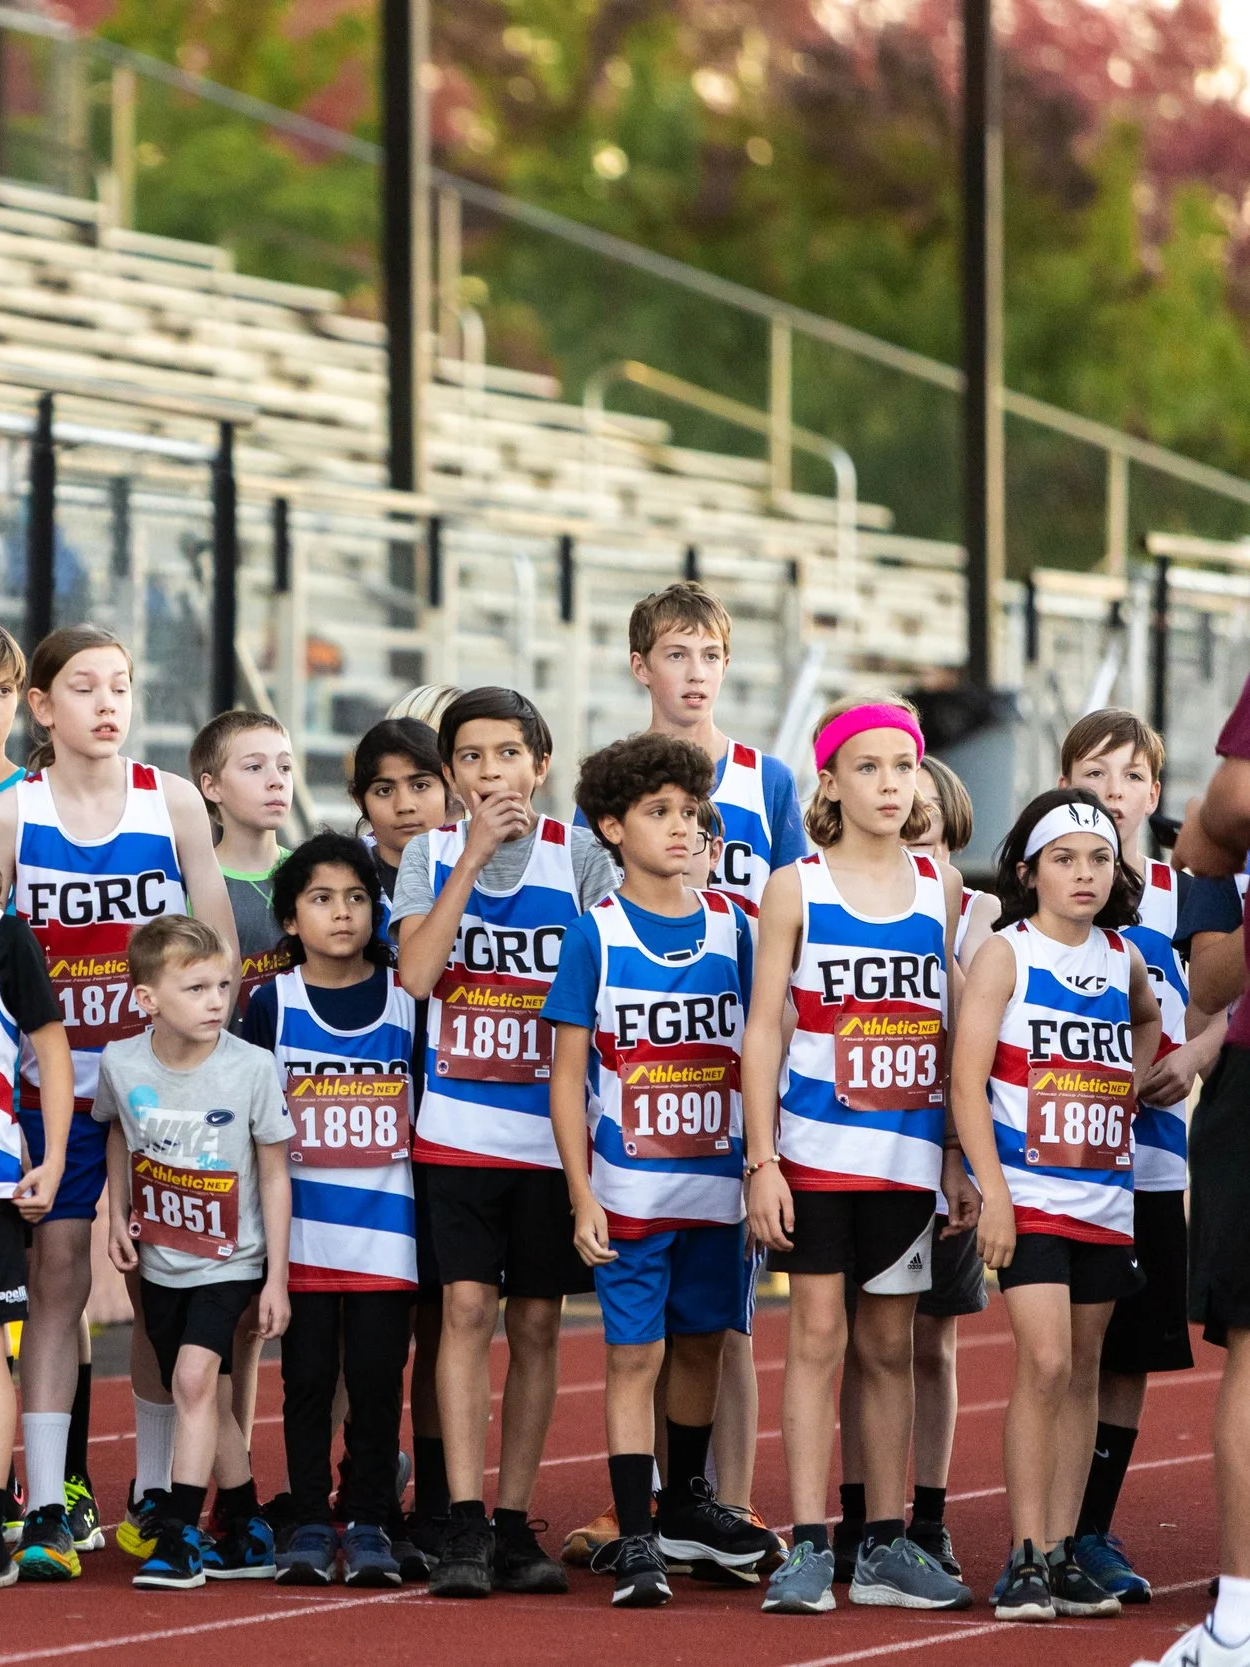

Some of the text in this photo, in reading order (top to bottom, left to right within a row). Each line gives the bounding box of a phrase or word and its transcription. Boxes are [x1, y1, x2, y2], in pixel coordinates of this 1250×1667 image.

[29, 870, 167, 926] FGRC
[49, 957, 127, 979] Athletic
[446, 985, 523, 1008] Athletic
[451, 1014, 541, 1061] 1891
[616, 993, 738, 1048] FGRC
[839, 1016, 918, 1036] Athletic
[626, 1064, 703, 1084] Athletic
[848, 1043, 937, 1088] 1893
[1032, 1071, 1110, 1094] Athletic
[291, 1077, 373, 1098] Athletic
[300, 1105, 399, 1148] 1898
[634, 1090, 722, 1137] 1890
[1039, 1101, 1125, 1148] 1886
[134, 1159, 205, 1190] Athletic
[141, 1184, 227, 1240] 1851
